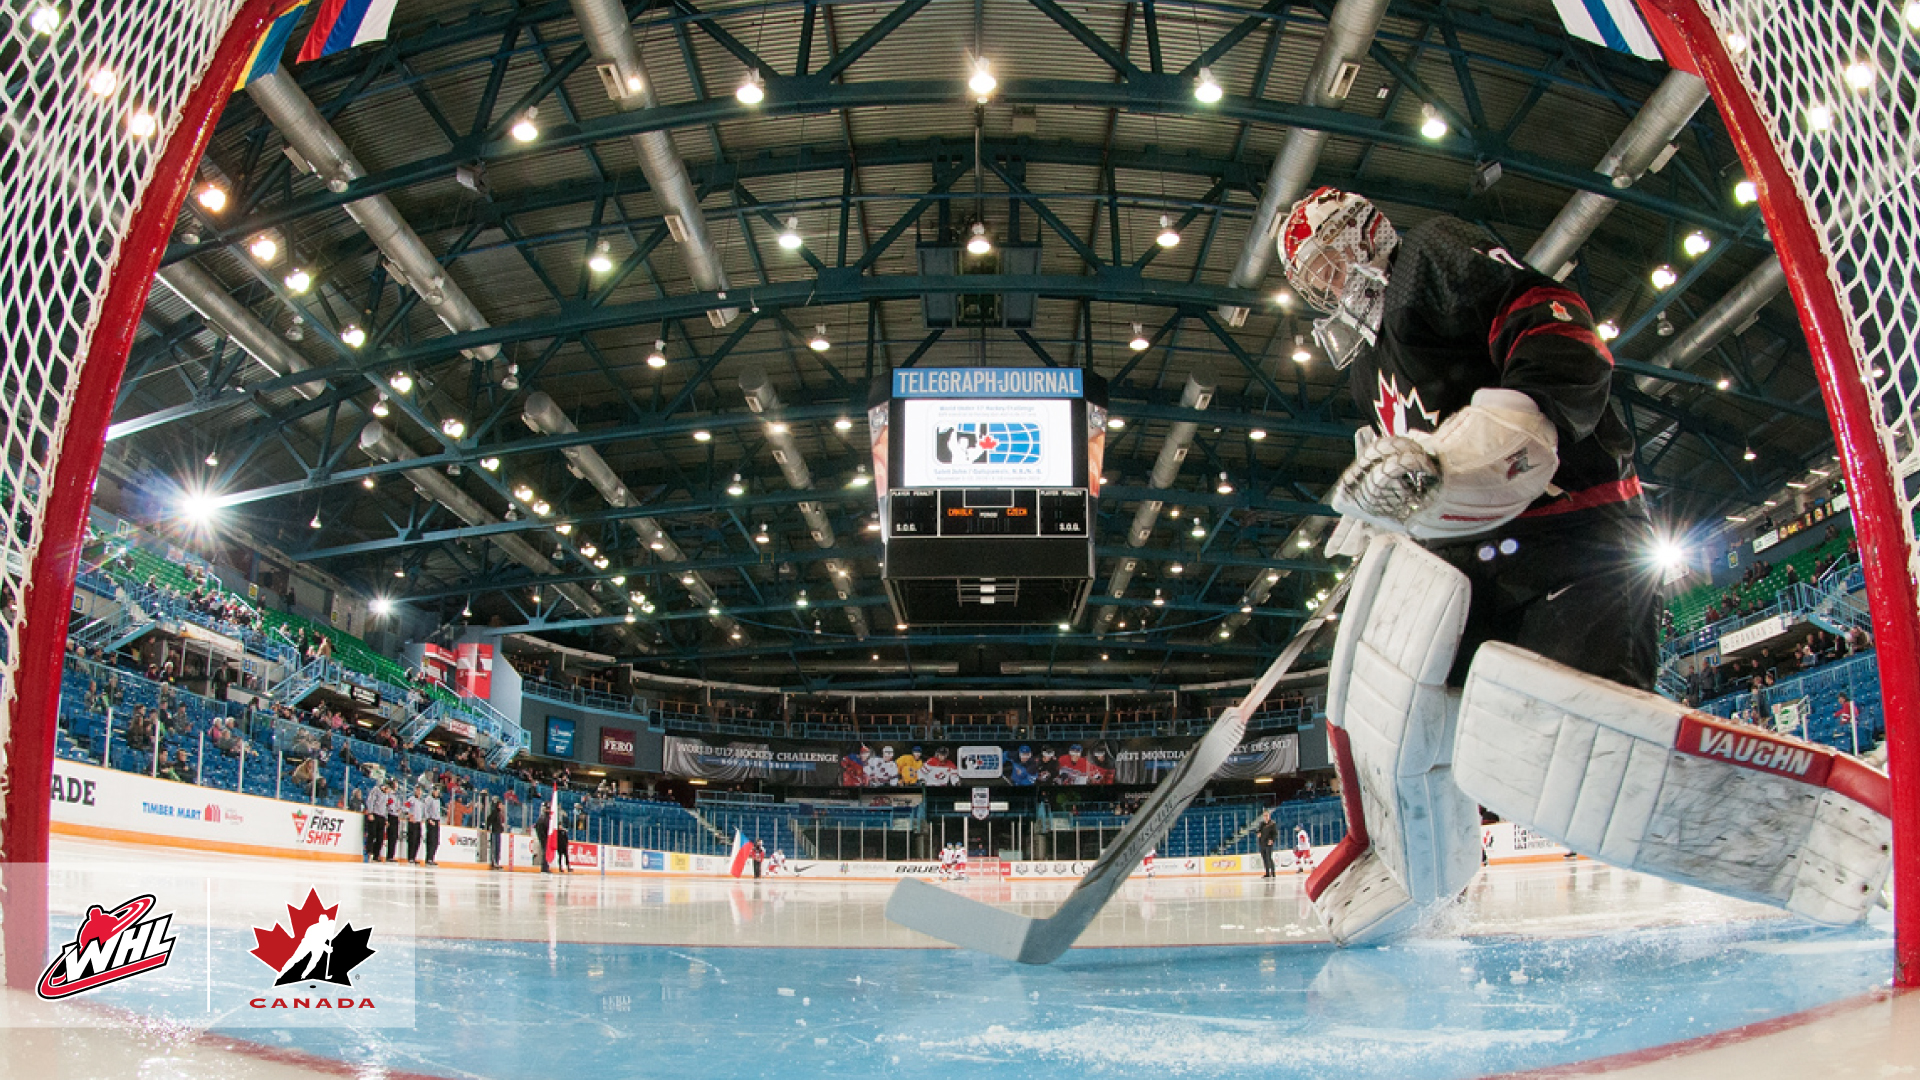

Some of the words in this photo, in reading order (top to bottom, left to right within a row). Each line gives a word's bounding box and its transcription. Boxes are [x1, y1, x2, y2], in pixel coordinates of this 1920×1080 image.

[603, 740, 634, 752] FERO
[677, 743, 713, 755] WORLD
[735, 748, 774, 760] HOCKEY
[776, 752, 839, 763] CHALLENGE
[1699, 726, 1814, 776] VAUGHN
[142, 801, 174, 817] TIMBER
[176, 807, 203, 820] MART
[310, 815, 345, 832] FIRST
[305, 830, 342, 847] SHIFT
